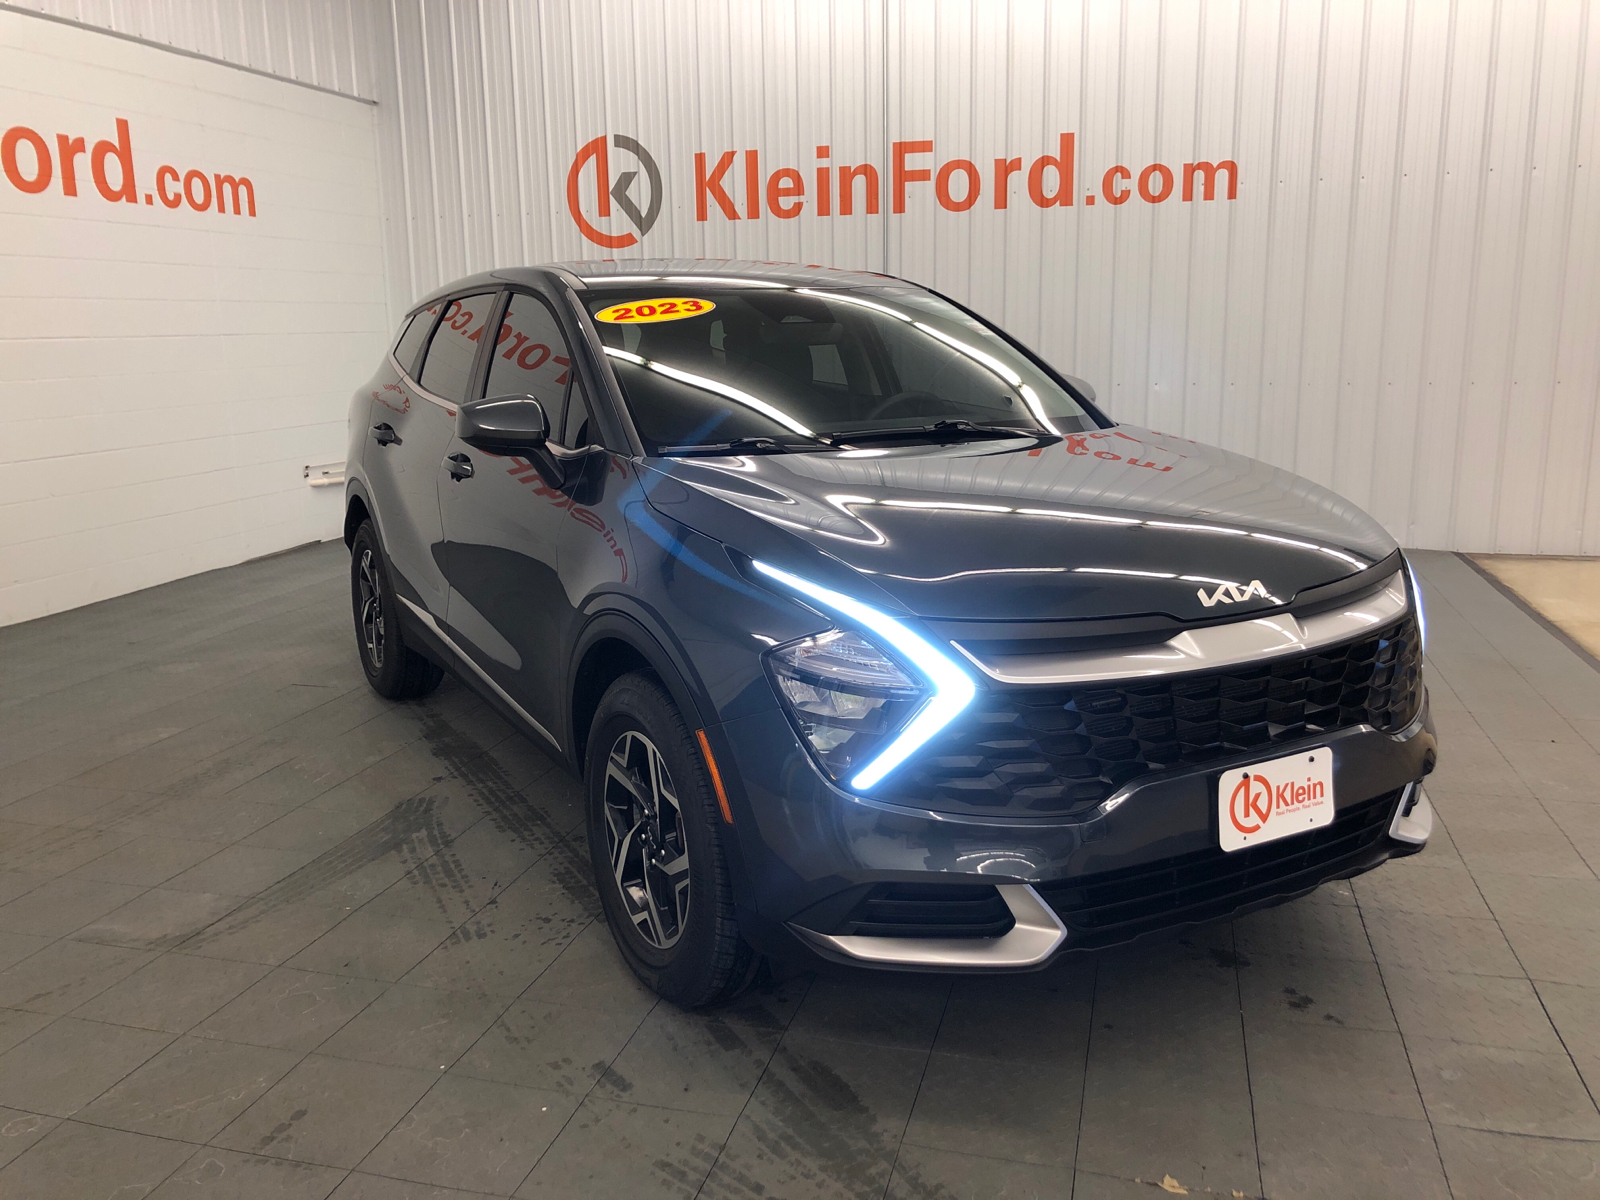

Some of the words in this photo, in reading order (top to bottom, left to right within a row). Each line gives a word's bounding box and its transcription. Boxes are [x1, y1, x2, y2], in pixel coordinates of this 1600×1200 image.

[694, 132, 1239, 221] KleinFord.com
[611, 299, 705, 321] 2023
[1197, 580, 1268, 607] KIA
[1275, 777, 1324, 809] Klein
